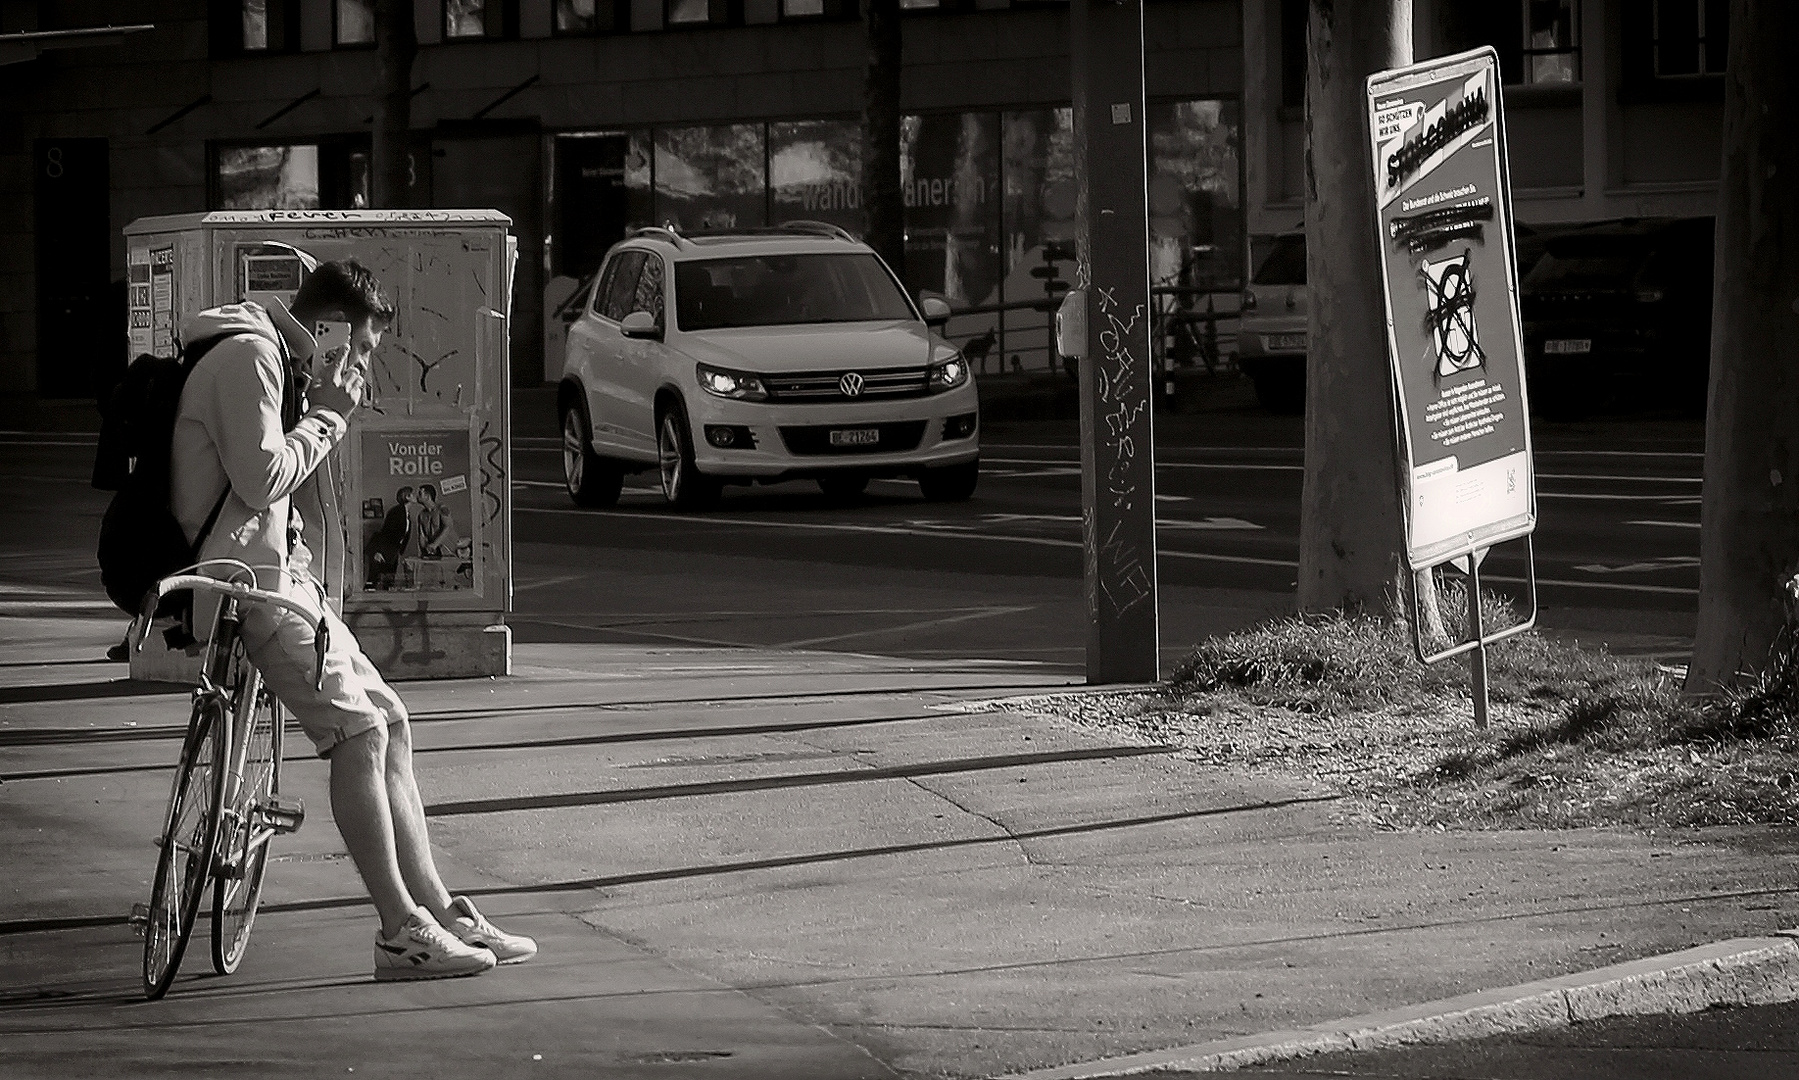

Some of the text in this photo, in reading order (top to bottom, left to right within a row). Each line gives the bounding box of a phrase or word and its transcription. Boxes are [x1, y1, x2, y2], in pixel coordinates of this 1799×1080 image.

[46, 147, 63, 178] 8
[387, 441, 443, 456] Von der
[389, 456, 444, 476] Rolle
